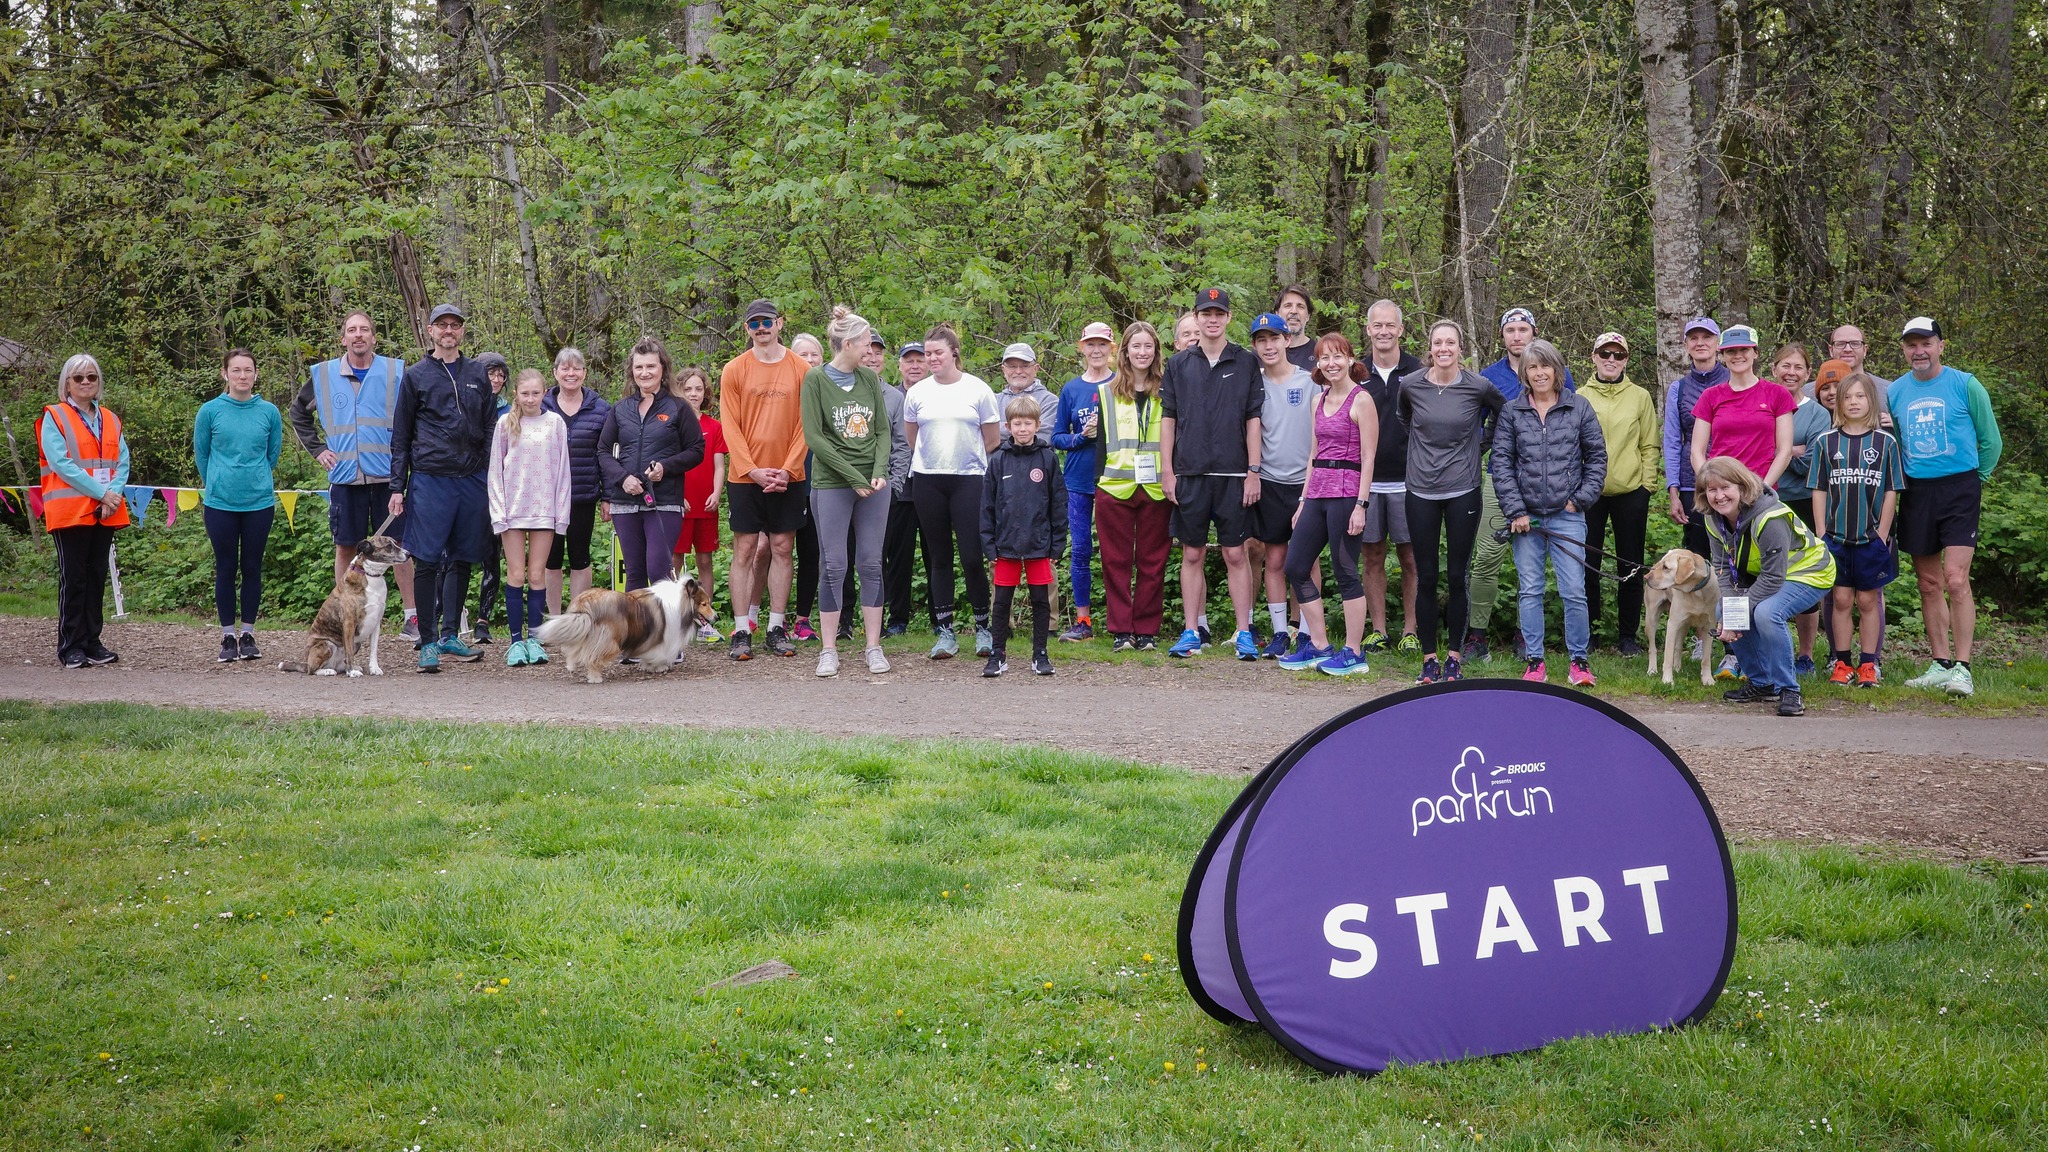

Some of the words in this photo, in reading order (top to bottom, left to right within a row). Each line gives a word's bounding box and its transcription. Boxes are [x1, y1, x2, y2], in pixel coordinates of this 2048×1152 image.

[832, 403, 869, 421] Holiday
[1910, 421, 1943, 430] CASTLE
[1910, 428, 1943, 437] COAST
[1507, 762, 1546, 775] BROOKS
[1490, 778, 1512, 786] presents
[1411, 770, 1554, 837] parkrun
[1323, 864, 1670, 979] START
